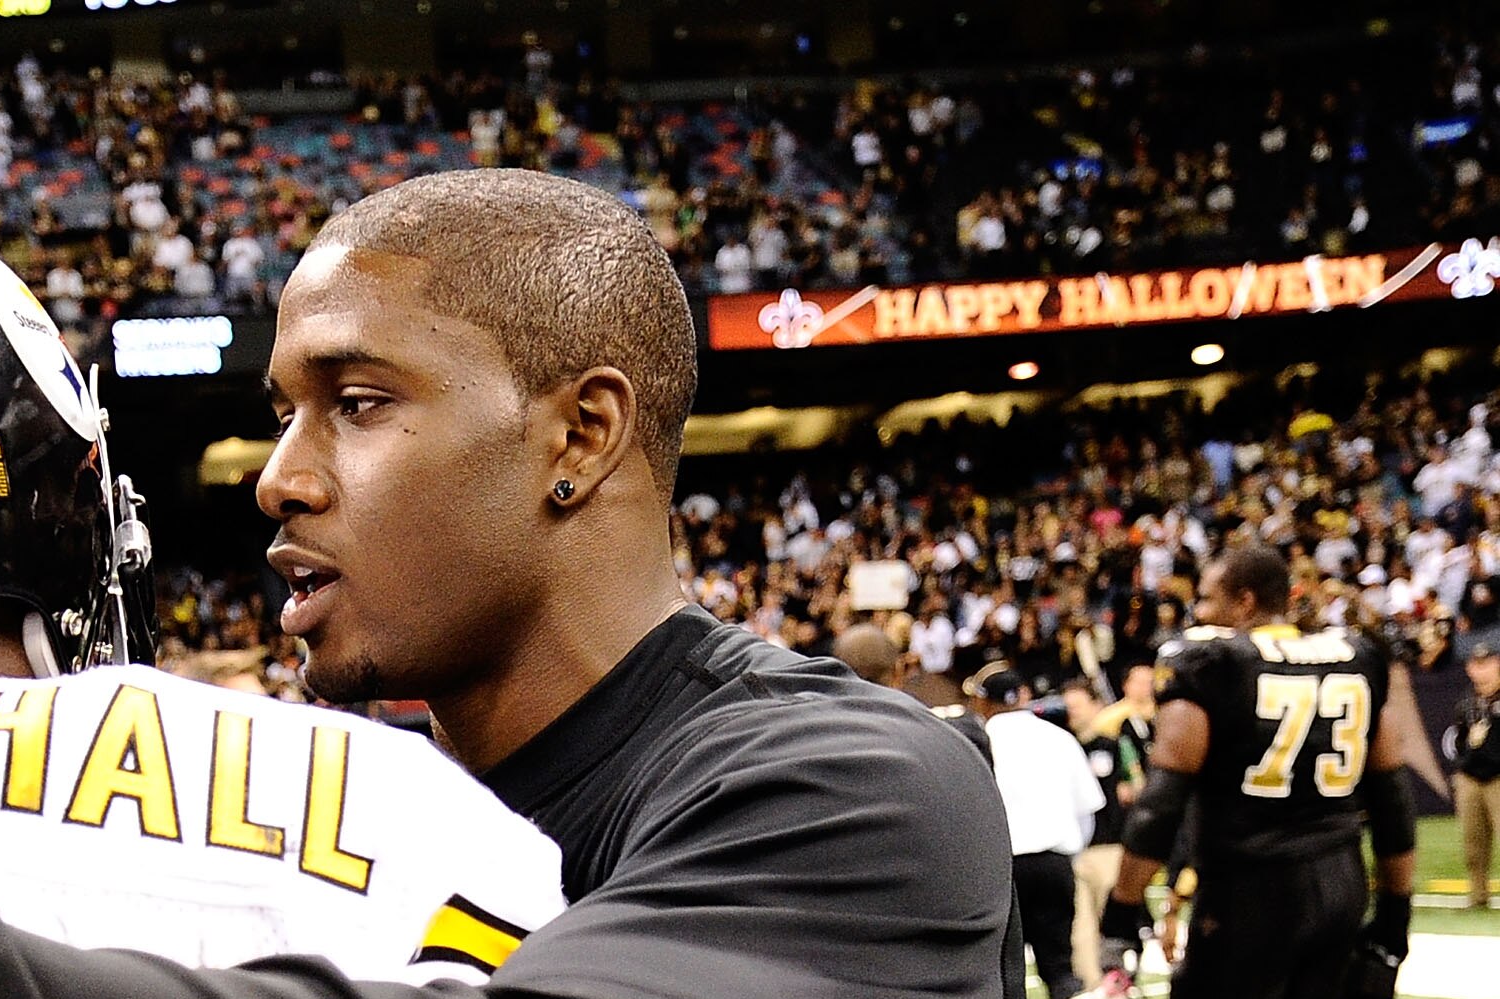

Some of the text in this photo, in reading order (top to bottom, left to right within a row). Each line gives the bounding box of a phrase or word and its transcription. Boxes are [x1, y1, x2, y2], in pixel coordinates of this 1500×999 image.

[874, 254, 1386, 338] HAPPY HALLOWEEN
[1241, 673, 1371, 798] 73
